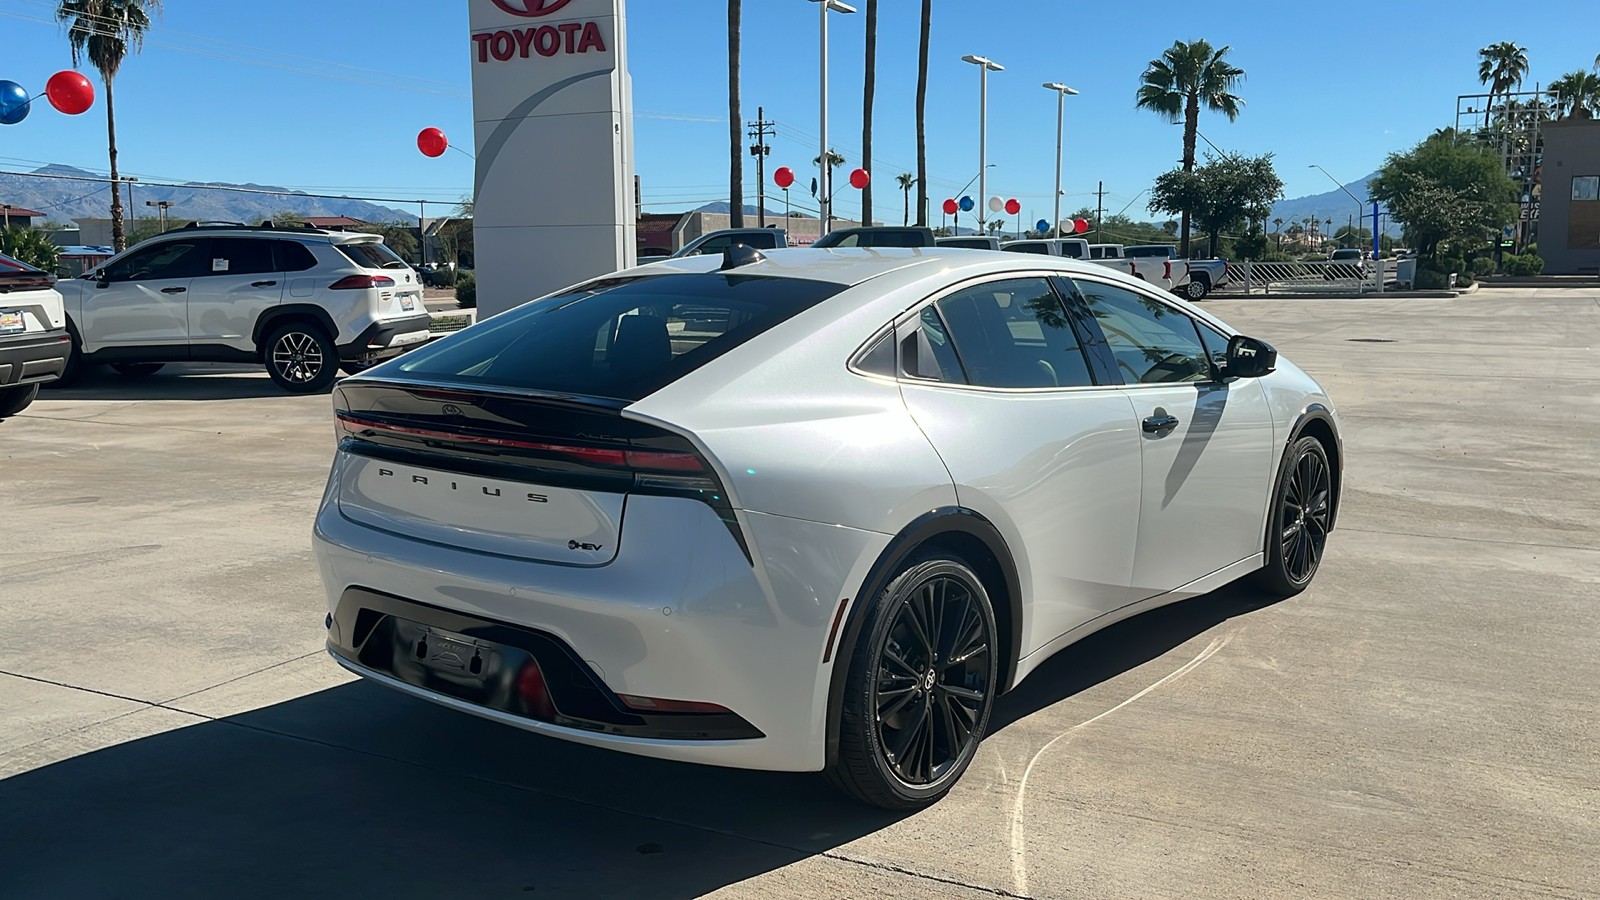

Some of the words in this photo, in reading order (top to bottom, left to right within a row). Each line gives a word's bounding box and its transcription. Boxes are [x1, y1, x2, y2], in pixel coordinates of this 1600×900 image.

[472, 22, 606, 63] TOYOTA
[379, 469, 548, 503] PRIUS
[575, 542, 603, 552] HEV
